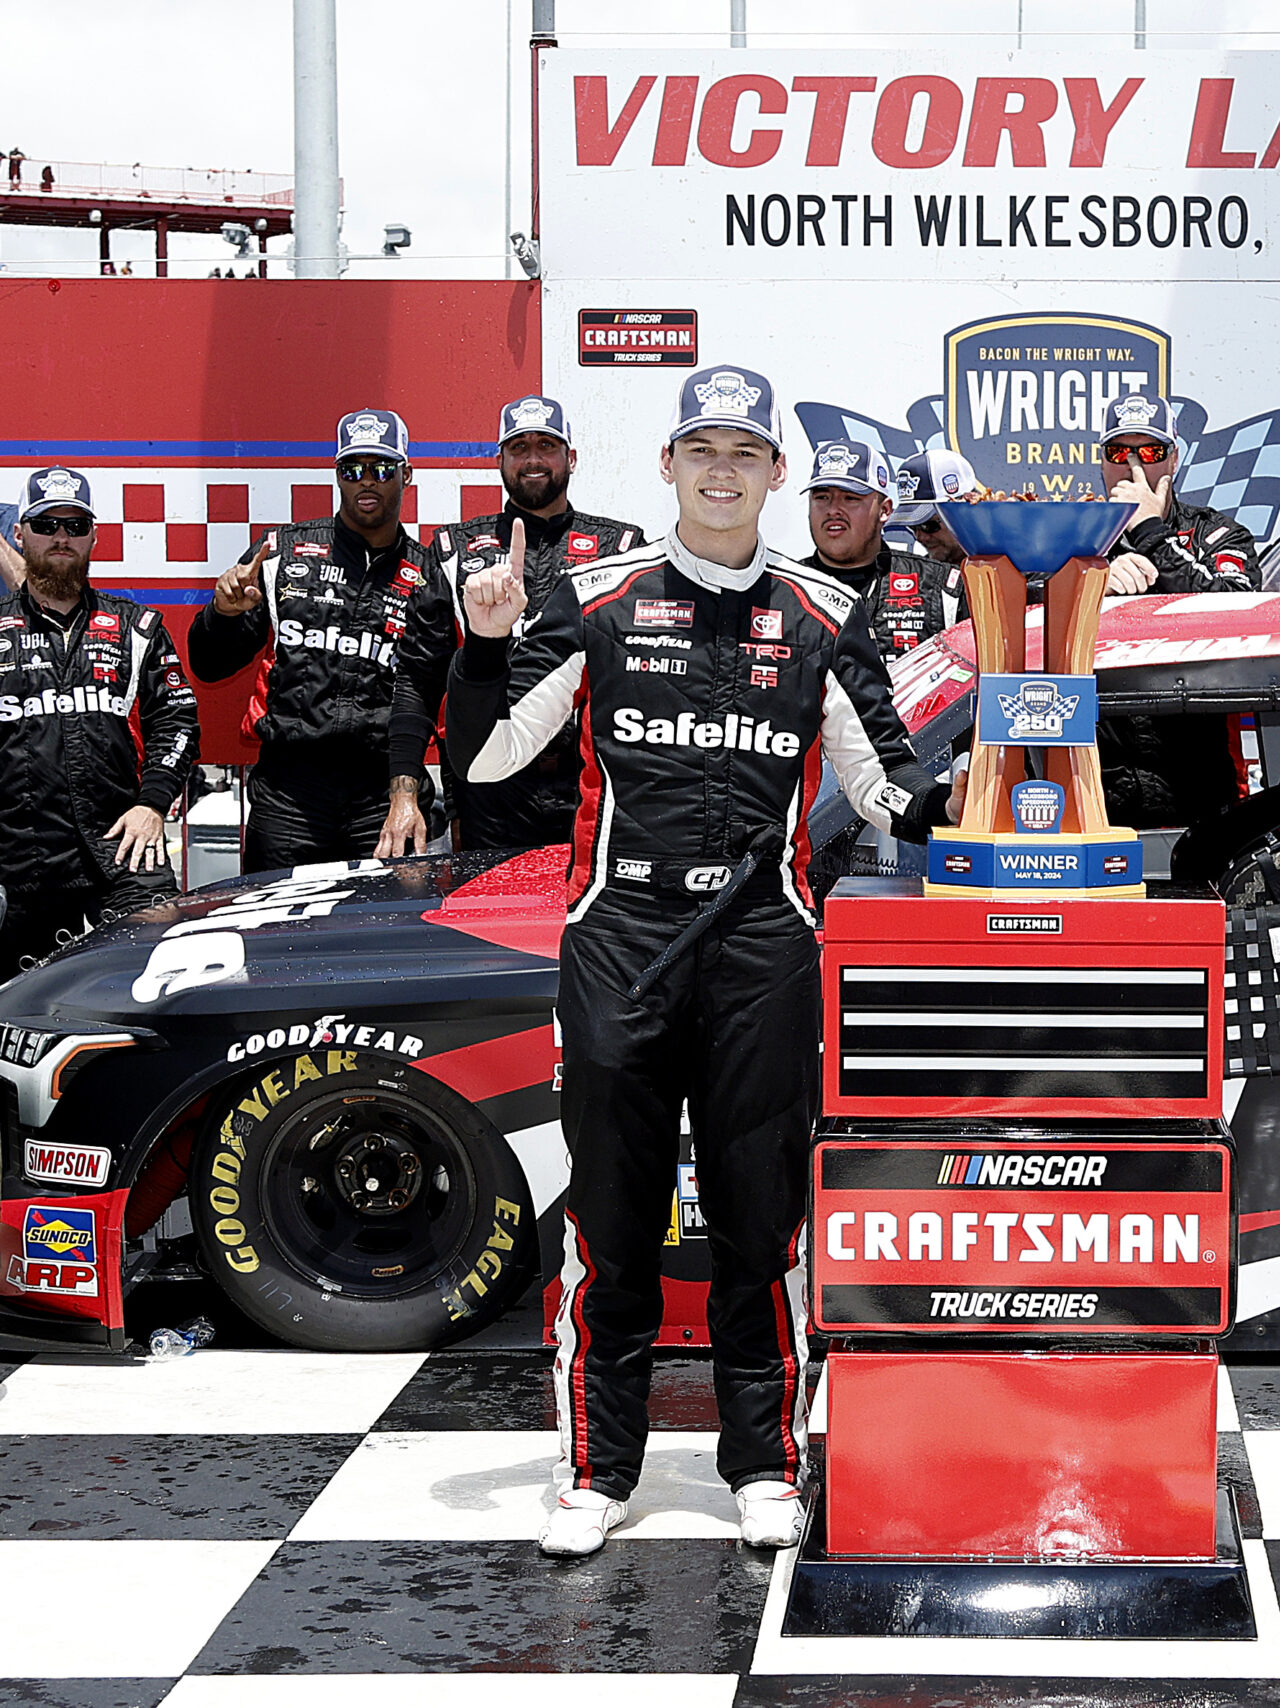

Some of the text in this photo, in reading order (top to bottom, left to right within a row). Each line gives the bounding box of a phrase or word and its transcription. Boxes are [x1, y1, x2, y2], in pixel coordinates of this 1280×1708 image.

[572, 74, 1146, 169] VICTORY
[726, 194, 892, 247] NORTH
[917, 194, 1264, 254] WILKESBORO,
[625, 314, 662, 323] NASCAR
[585, 330, 690, 346] CRAFTSMAN
[614, 353, 662, 362] TRUCK SERIES
[979, 348, 1135, 361] BACON THE WRIGHT WAY.
[966, 370, 1148, 440] WRIGHT
[1023, 482, 1035, 493] 19
[1077, 482, 1092, 493] 22
[320, 565, 347, 584] JBL
[579, 573, 612, 587] OMP
[818, 589, 849, 608] OMP
[638, 609, 690, 618] CRAFTSMAN
[21, 632, 49, 650] JBL
[625, 635, 692, 650] GOODYEAR
[739, 643, 791, 661] TRD
[626, 656, 669, 673] Mobil
[0, 685, 128, 721] Safelite
[1025, 691, 1053, 702] WRIGHT
[1016, 714, 1061, 730] 250
[613, 708, 800, 757] Safelite
[616, 863, 651, 878] OMP
[1000, 855, 1078, 869] WINNER
[991, 919, 1058, 930] CRAFTSMAN
[226, 1017, 424, 1062] GOODYEAR
[28, 1147, 101, 1178] SIMPSON
[210, 1050, 358, 1273] GOODYEAR
[978, 1156, 1107, 1186] NASCAR
[29, 1229, 89, 1245] SUNOCO
[827, 1211, 1199, 1263] CRAFTSMAN
[8, 1258, 94, 1289] ARP
[929, 1292, 1098, 1318] TRUCK SERIES
